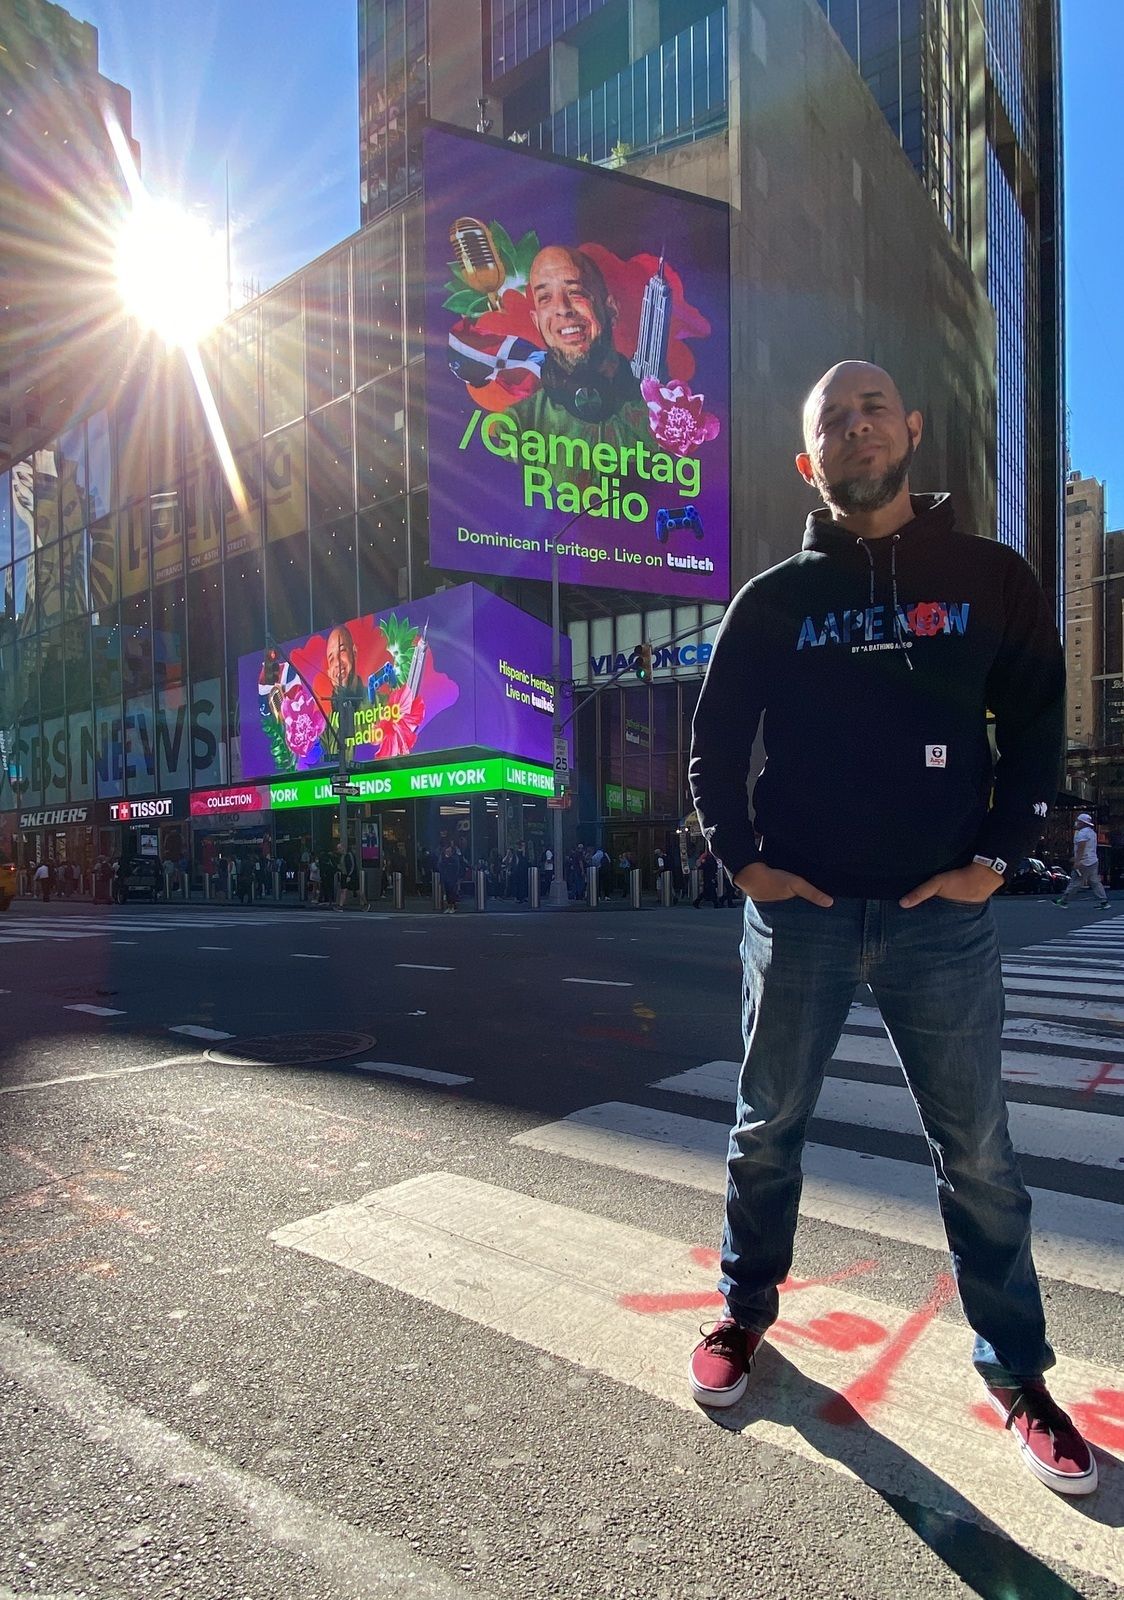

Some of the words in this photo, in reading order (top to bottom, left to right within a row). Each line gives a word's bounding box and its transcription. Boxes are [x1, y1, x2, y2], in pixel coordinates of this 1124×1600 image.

[459, 409, 701, 498] /Gamertag
[523, 465, 649, 523] Radio
[457, 527, 541, 552] Dominican
[544, 539, 611, 562] Heritage.
[614, 548, 642, 566] Live
[645, 555, 663, 568] on
[666, 553, 714, 572] twitch
[796, 605, 885, 651] AAPE
[499, 659, 530, 684] Hispanic
[506, 682, 520, 701] Live
[521, 692, 531, 705] on
[81, 699, 217, 785] NEWS
[506, 767, 527, 785] LINE
[555, 757, 568, 771] 25
[270, 788, 299, 803] YORK
[314, 784, 341, 800] LIN
[411, 773, 443, 790] NEW
[447, 768, 486, 785] YORK
[130, 800, 172, 817] TISSOT
[207, 794, 252, 808] COLLECTION
[20, 807, 88, 828] SKECHERS
